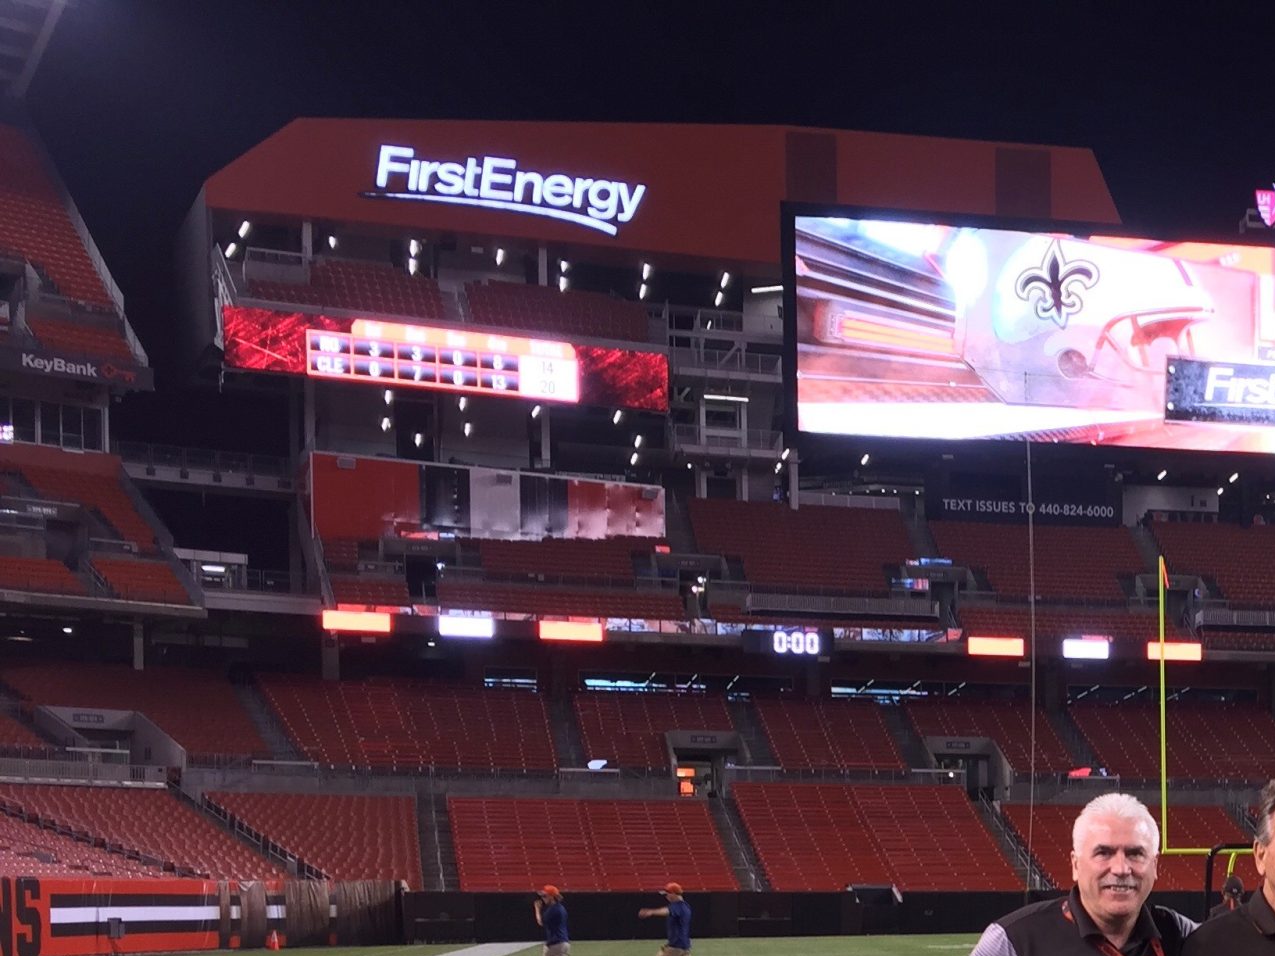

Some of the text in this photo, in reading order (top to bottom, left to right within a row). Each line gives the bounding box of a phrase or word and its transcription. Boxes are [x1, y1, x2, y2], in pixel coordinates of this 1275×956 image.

[375, 144, 646, 223] FirstEnergy
[368, 341, 380, 358] 3
[411, 345, 423, 362] 3
[21, 352, 98, 377] KeyBank
[316, 355, 344, 374] CLE
[411, 364, 423, 383] 7
[942, 498, 1115, 518] TEXT ISSUES TO 440-824-6000
[773, 630, 819, 655] 0:00
